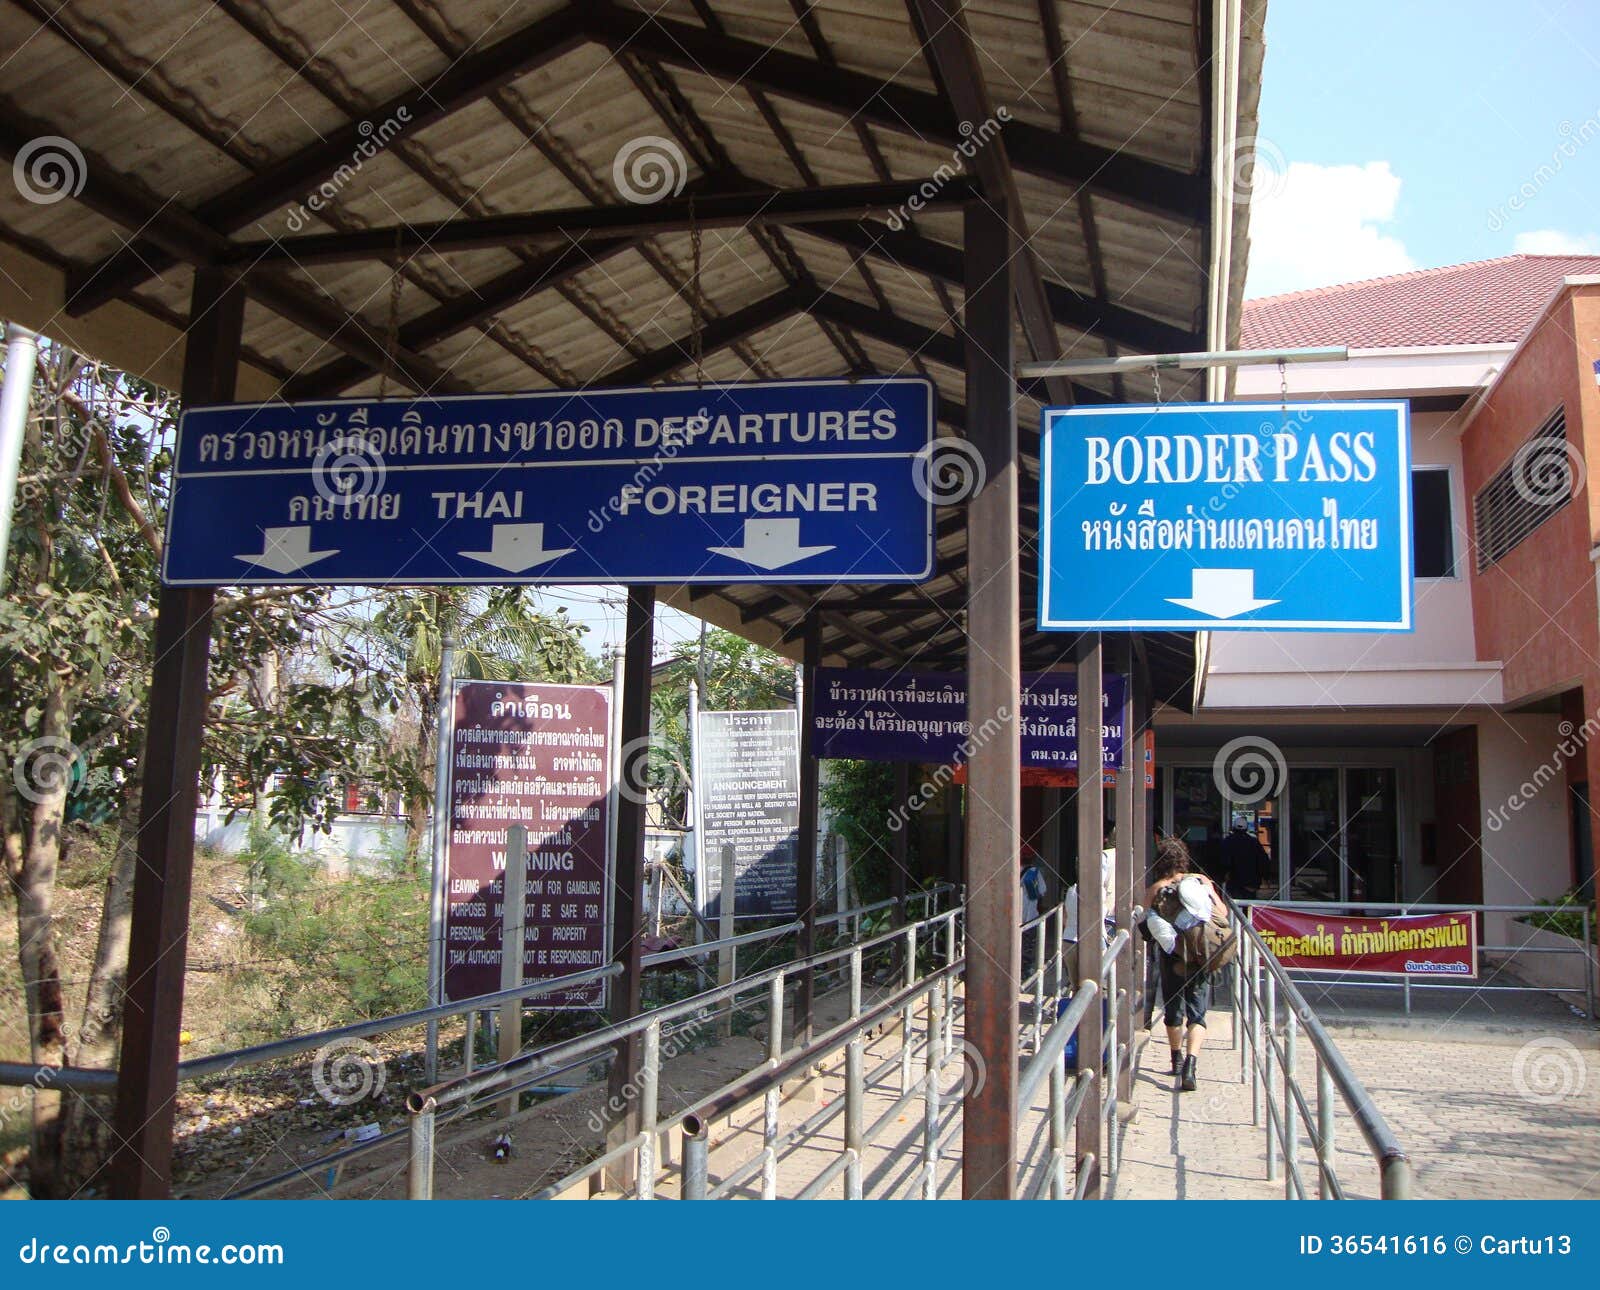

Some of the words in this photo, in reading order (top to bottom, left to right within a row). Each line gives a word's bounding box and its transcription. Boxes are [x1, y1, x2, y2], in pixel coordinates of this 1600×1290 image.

[199, 407, 624, 462] ตรวจหนังสือเดินทางขาออก
[634, 409, 897, 448] DEPARTURES
[1084, 433, 1263, 486] BORDER
[1274, 431, 1377, 483] PASS
[288, 475, 401, 521] คนไทย
[431, 490, 524, 519] THAI
[619, 482, 879, 516] FOREIGNER
[1080, 497, 1378, 550] หนังสือผ่านแดนคนไทย
[712, 780, 788, 791] ANNOUNCEMENT
[491, 851, 574, 870] WRNING
[451, 879, 480, 894] LEAVING
[488, 880, 503, 894] THE
[548, 881, 561, 894] FOR
[566, 881, 601, 895] GAMBLING
[450, 903, 487, 917] PURPOSES
[494, 903, 505, 917] MA
[542, 904, 552, 918] BE
[561, 904, 578, 918] SAFE
[585, 904, 599, 918] FOR
[450, 926, 486, 941] PERSONAL
[525, 927, 539, 941] AND
[552, 927, 588, 941] PROPERTY
[538, 950, 547, 964] BE
